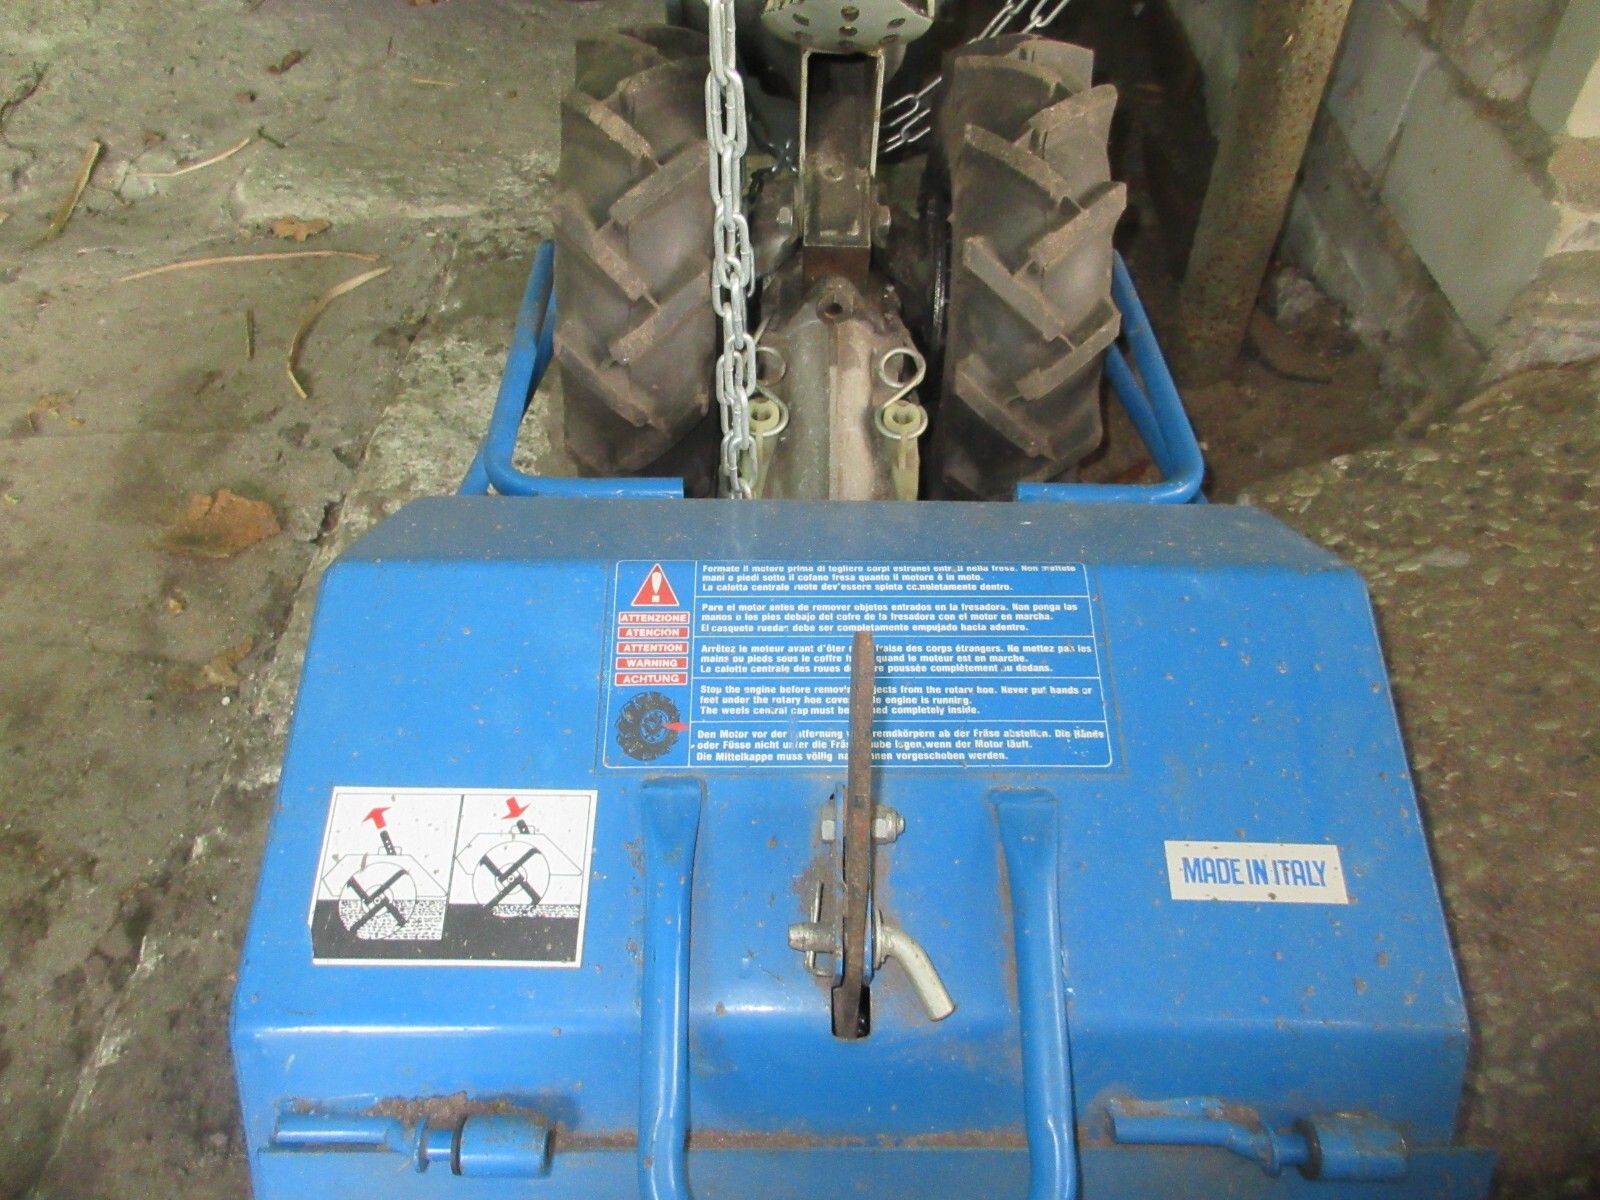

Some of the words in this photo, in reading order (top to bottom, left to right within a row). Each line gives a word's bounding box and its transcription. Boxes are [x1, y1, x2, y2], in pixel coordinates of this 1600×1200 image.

[702, 565, 740, 573] Fermate
[752, 565, 784, 573] motore
[787, 565, 814, 574] prima
[816, 565, 826, 573] di
[828, 565, 863, 574] togliere
[866, 565, 890, 574] corpi
[702, 574, 725, 582] mani
[737, 574, 759, 583] piedi
[762, 574, 785, 582] sotto
[788, 574, 794, 582] il
[797, 574, 829, 582] cofano
[832, 574, 856, 582] fresa
[858, 574, 890, 583] quanto
[702, 583, 713, 591] La
[716, 583, 748, 591] calotta
[751, 583, 790, 591] centrale
[794, 583, 818, 591] ruote
[821, 583, 872, 591] dev'essere
[874, 583, 903, 593] spinta
[980, 583, 1013, 591] dentro.
[702, 603, 723, 611] Pare
[726, 603, 735, 611] el
[738, 603, 766, 611] motor
[769, 603, 795, 611] antes
[797, 603, 809, 611] de
[854, 603, 888, 613] objetos
[891, 603, 932, 611] entrados
[949, 603, 958, 611] la
[961, 603, 1009, 611] fresadora.
[1012, 603, 1030, 611] Non
[1063, 603, 1078, 611] las
[620, 614, 686, 622] ATTENZIONE
[744, 613, 758, 621] los
[761, 613, 781, 623] pies
[784, 613, 816, 623] debajo
[818, 613, 833, 621] del
[836, 613, 861, 621] cofre
[864, 613, 876, 621] de
[878, 613, 888, 621] la
[890, 613, 935, 621] fresadora
[958, 613, 967, 621] el
[970, 613, 998, 621] motor
[1015, 613, 1053, 621] marcha.
[625, 628, 680, 637] ATENCION
[711, 624, 754, 633] casquete
[792, 624, 815, 632] debe
[837, 624, 909, 633] completamente
[912, 624, 958, 633] empujado
[623, 644, 683, 652] ATTENTION
[701, 644, 736, 653] Arrêtez
[739, 644, 748, 653] le
[751, 644, 784, 653] moteur
[787, 644, 814, 653] avant
[817, 644, 845, 653] d'ôter
[875, 644, 904, 653] fraise
[906, 645, 923, 653] des
[925, 646, 953, 654] corps
[955, 645, 1003, 654] étrangers.
[1007, 645, 1022, 653] Ne
[1025, 645, 1055, 653] mettez
[1078, 645, 1092, 653] les
[626, 659, 678, 667] WARNING
[701, 655, 729, 663] mains
[747, 655, 773, 665] pieds
[801, 655, 810, 663] le
[813, 655, 842, 663] coffre
[876, 655, 905, 665] quand
[908, 655, 917, 663] le
[920, 655, 953, 663] moteur
[956, 655, 972, 663] est
[989, 655, 1028, 663] marche.
[700, 665, 711, 673] La
[714, 665, 748, 673] calotte
[750, 665, 790, 673] centrale
[793, 665, 810, 673] des
[887, 665, 927, 674] poussée
[930, 665, 998, 674] complètement
[1016, 665, 1053, 673] dedans.
[622, 674, 680, 684] ACHTUNG
[700, 685, 722, 695] Stop
[725, 685, 740, 694] the
[744, 685, 776, 695] engine
[779, 685, 811, 694] before
[900, 686, 923, 694] from
[926, 686, 942, 694] the
[945, 686, 974, 695] rotary
[976, 686, 998, 694] hoe.
[1001, 686, 1028, 694] Never
[1049, 686, 1079, 694] hands
[700, 695, 719, 704] feet
[722, 695, 750, 704] under
[753, 695, 769, 704] the
[772, 695, 801, 705] rotary
[804, 695, 822, 704] hoe
[884, 695, 917, 706] engine
[920, 696, 929, 704] is
[932, 696, 972, 706] running.
[700, 706, 718, 715] The
[721, 706, 750, 715] weels
[791, 707, 808, 716] cap
[810, 706, 835, 715] must
[891, 706, 945, 716] completely
[947, 706, 980, 714] inside.
[697, 730, 716, 738] Den
[719, 730, 749, 738] Motor
[770, 730, 788, 738] der
[938, 730, 950, 738] ab
[953, 730, 970, 738] der
[973, 730, 1000, 738] Fräse
[1054, 730, 1071, 738] Die
[1074, 730, 1104, 738] Hände
[697, 741, 720, 749] oder
[723, 741, 751, 749] Füsse
[754, 741, 779, 749] nicht
[812, 741, 827, 749] die
[925, 741, 952, 749] wenn
[955, 740, 972, 749] der
[975, 740, 1004, 749] Motor
[697, 752, 712, 761] Die
[715, 752, 773, 762] Mittelkappe
[806, 752, 833, 762] völlig
[896, 751, 965, 761] vorgeschoben
[968, 751, 1008, 760] werden.
[1181, 857, 1244, 885] MADE
[1245, 858, 1269, 885] IN
[1272, 859, 1327, 887] ITALY
